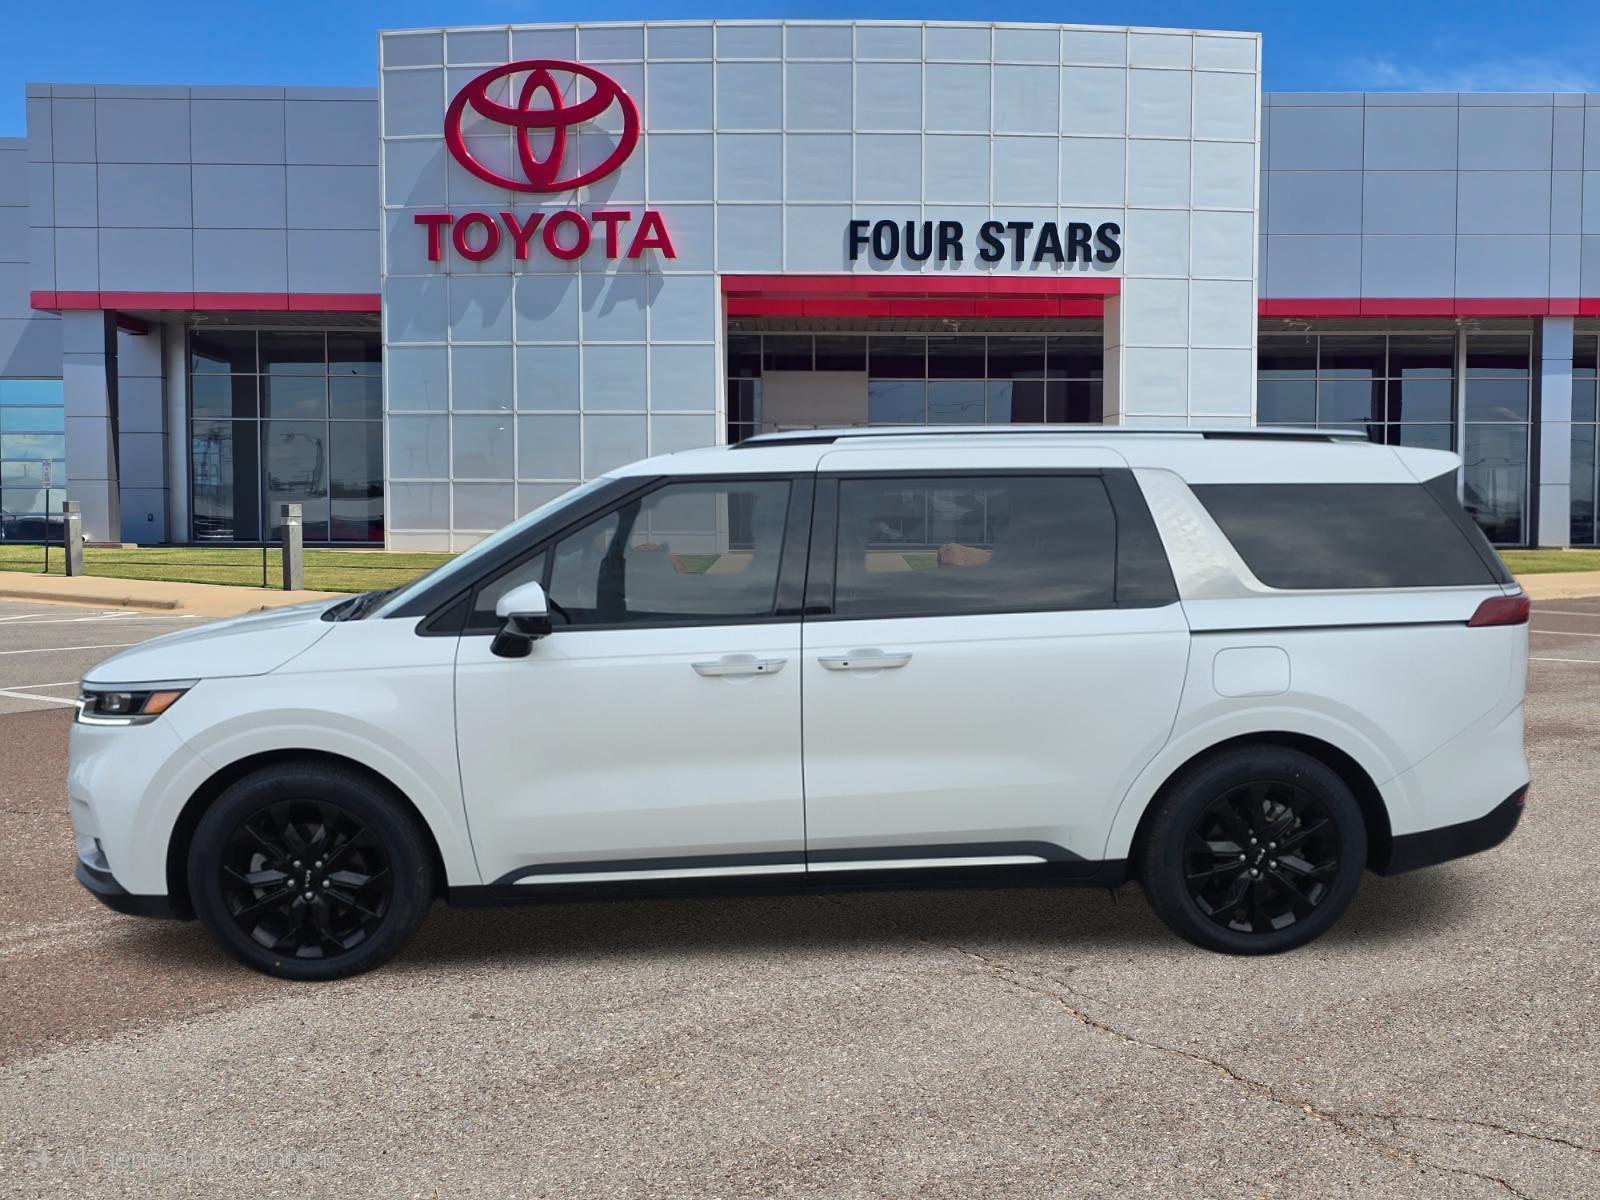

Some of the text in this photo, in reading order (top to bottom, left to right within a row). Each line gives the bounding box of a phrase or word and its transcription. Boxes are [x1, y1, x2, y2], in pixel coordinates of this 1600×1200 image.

[414, 210, 677, 261] TOYOTA
[849, 219, 1121, 263] FOUR STARS
